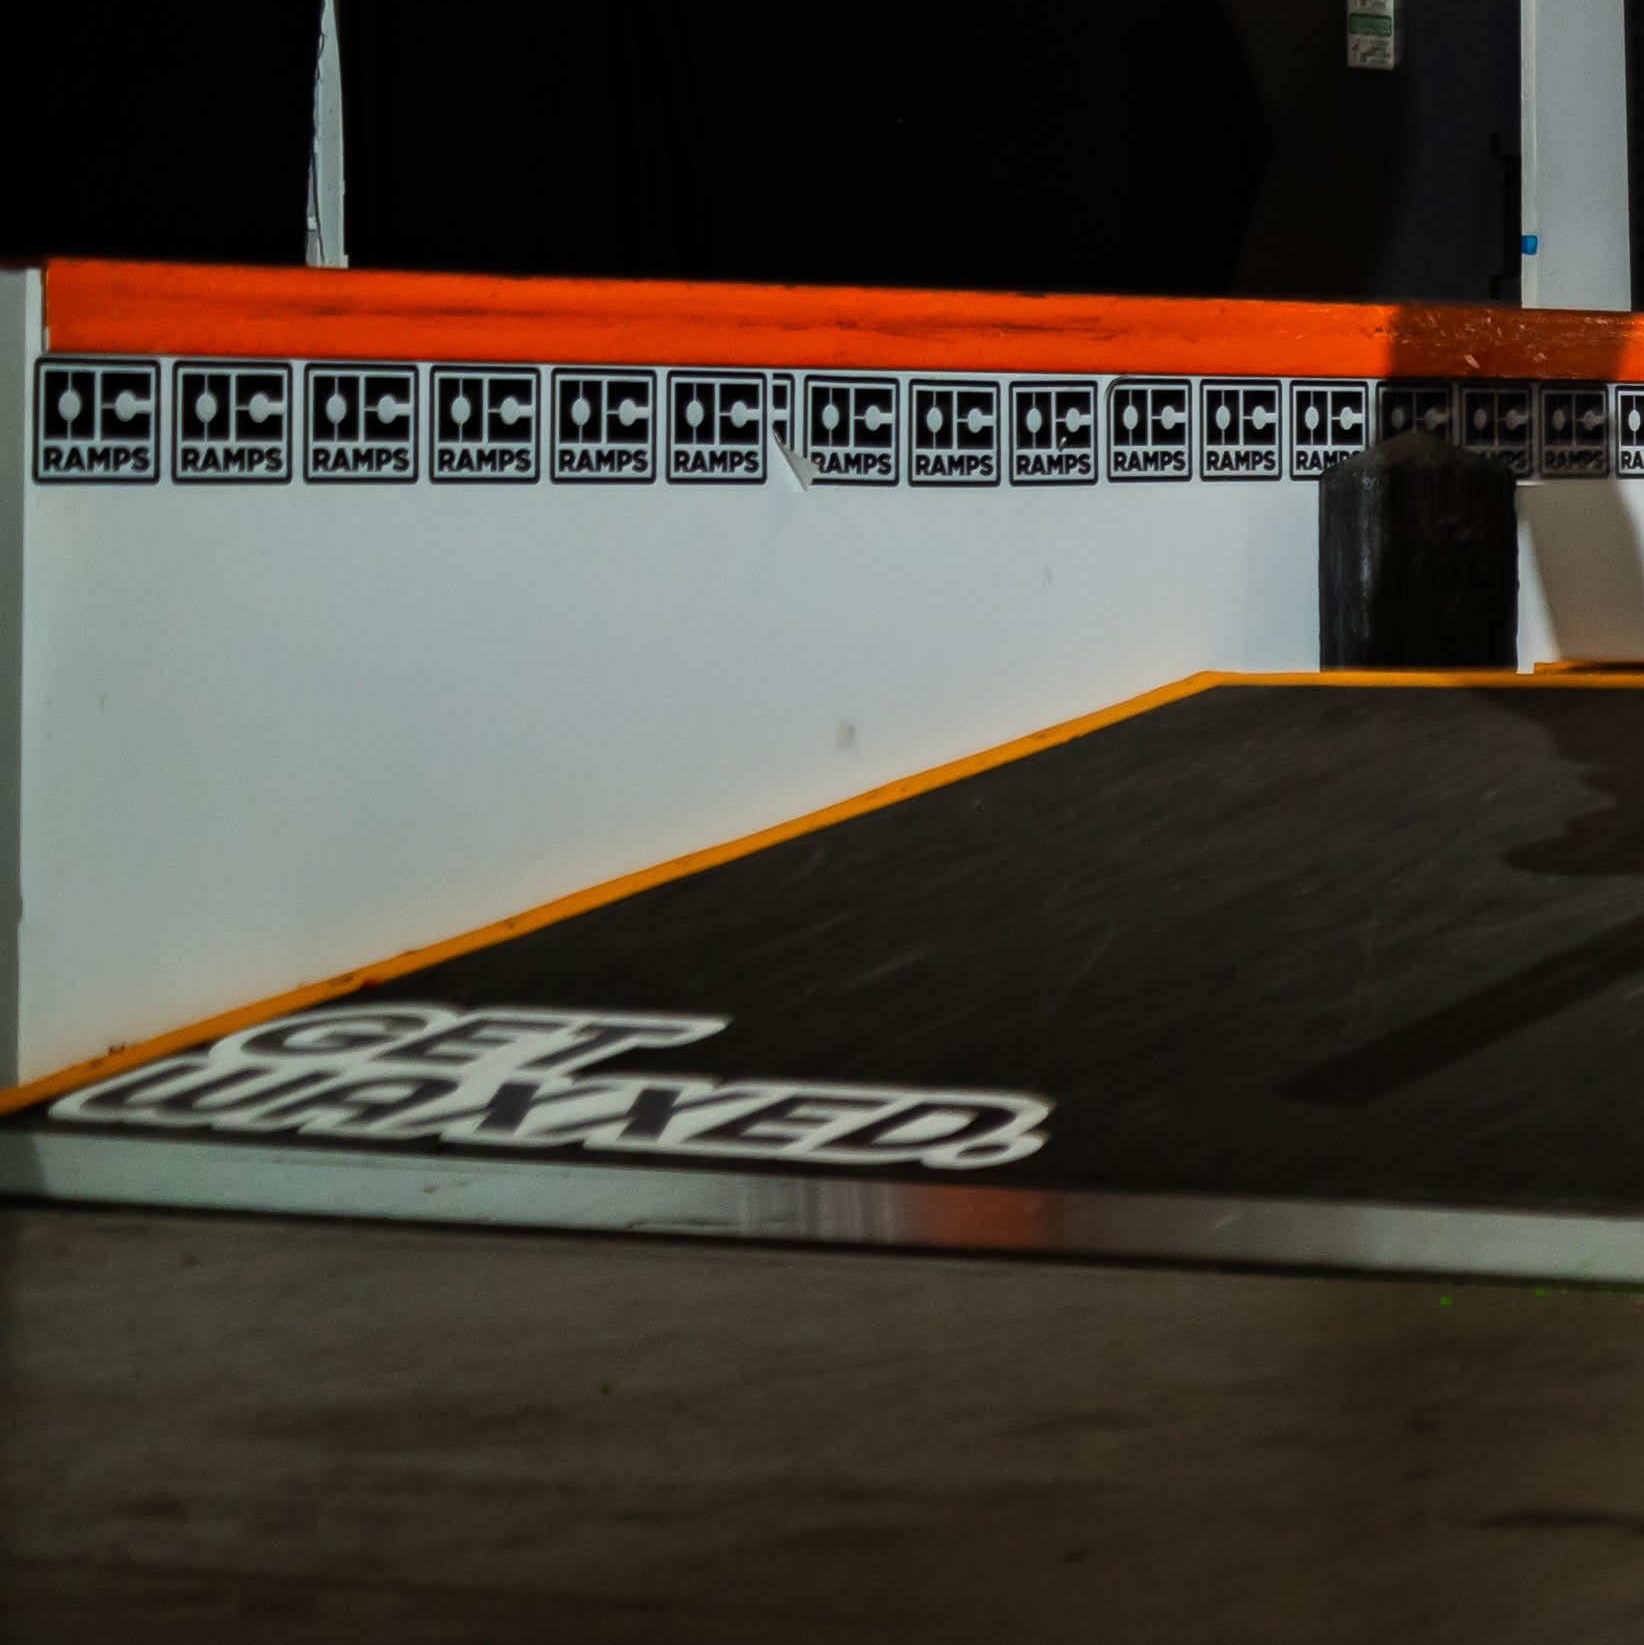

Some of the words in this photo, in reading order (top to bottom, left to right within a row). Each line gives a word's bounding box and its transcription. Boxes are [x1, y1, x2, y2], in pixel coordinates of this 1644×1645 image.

[43, 446, 150, 472] RAMPS
[181, 446, 282, 472] RAMPS
[312, 447, 410, 473] RAMPS
[438, 449, 532, 473] RAMPS
[558, 449, 648, 473] RAMPS
[674, 449, 759, 473] RAMPS
[811, 452, 892, 475] RAMPS
[915, 454, 994, 477] RAMPS
[1016, 454, 1091, 476] RAMPS
[1114, 451, 1186, 472] RAMPS
[1206, 450, 1276, 471] RAMPS
[1545, 451, 1604, 469] RAMPS
[210, 1004, 730, 1076] GET
